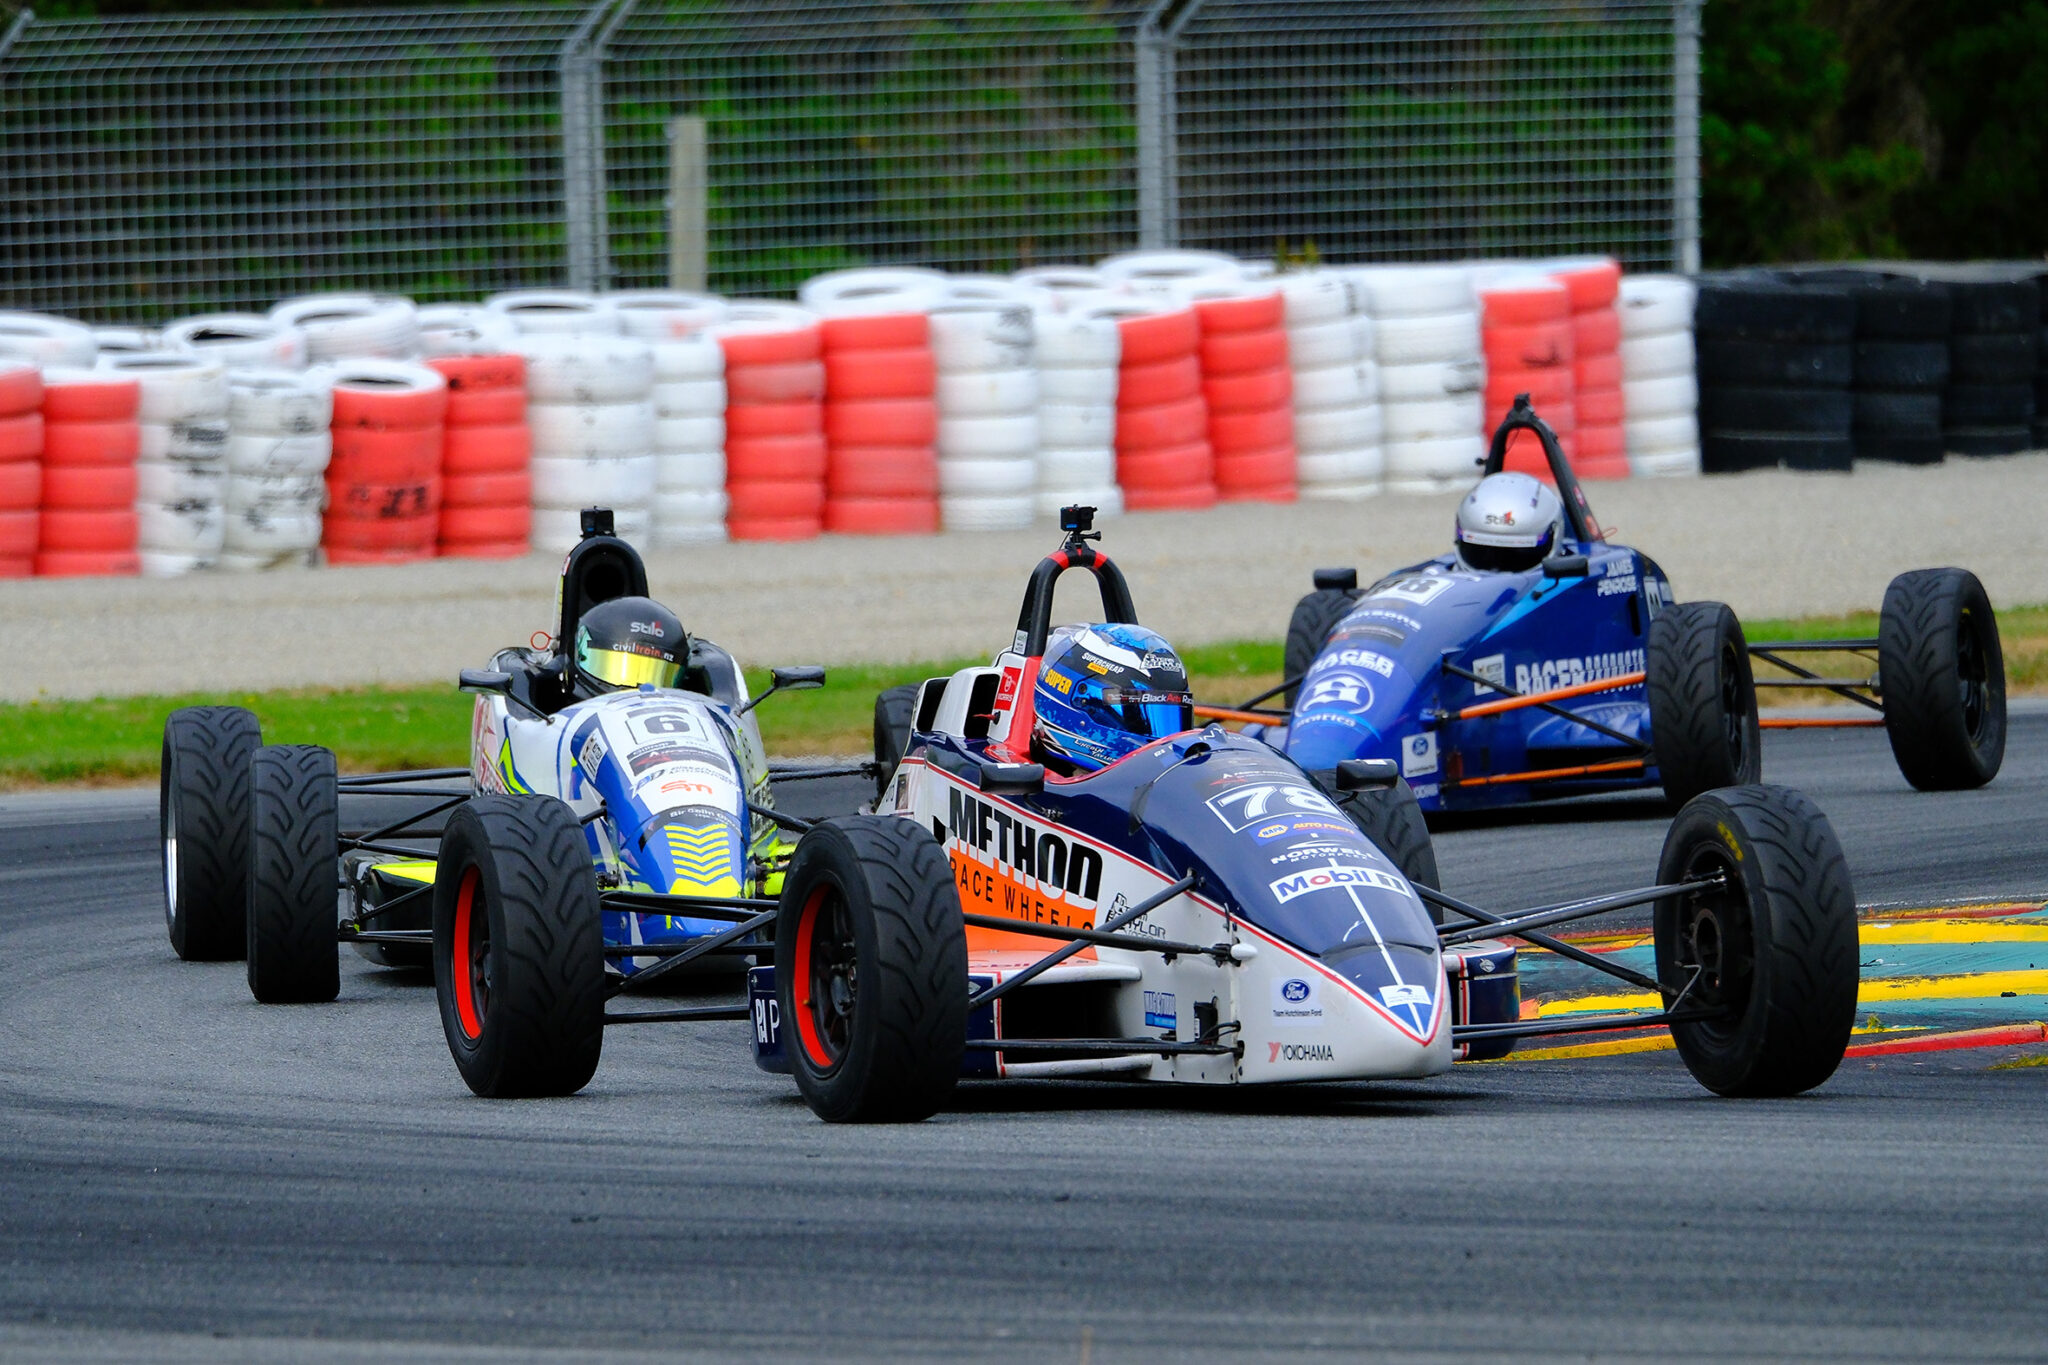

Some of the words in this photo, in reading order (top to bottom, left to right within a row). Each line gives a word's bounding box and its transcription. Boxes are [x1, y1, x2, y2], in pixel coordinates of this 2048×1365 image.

[1606, 559, 1634, 578] JAMES
[1597, 574, 1637, 598] PENROSE
[630, 621, 665, 638] Stilo
[1081, 652, 1125, 675] SUPERCHEAP
[1044, 668, 1073, 696] SUPER
[643, 714, 691, 734] 6
[1217, 785, 1343, 819] 78
[1262, 825, 1285, 836] NAPA
[949, 785, 1104, 911] METHOD
[1270, 848, 1380, 865] NORWELL
[1276, 869, 1373, 898] Mobil
[1281, 1045, 1334, 1061] YOKOHAMA
